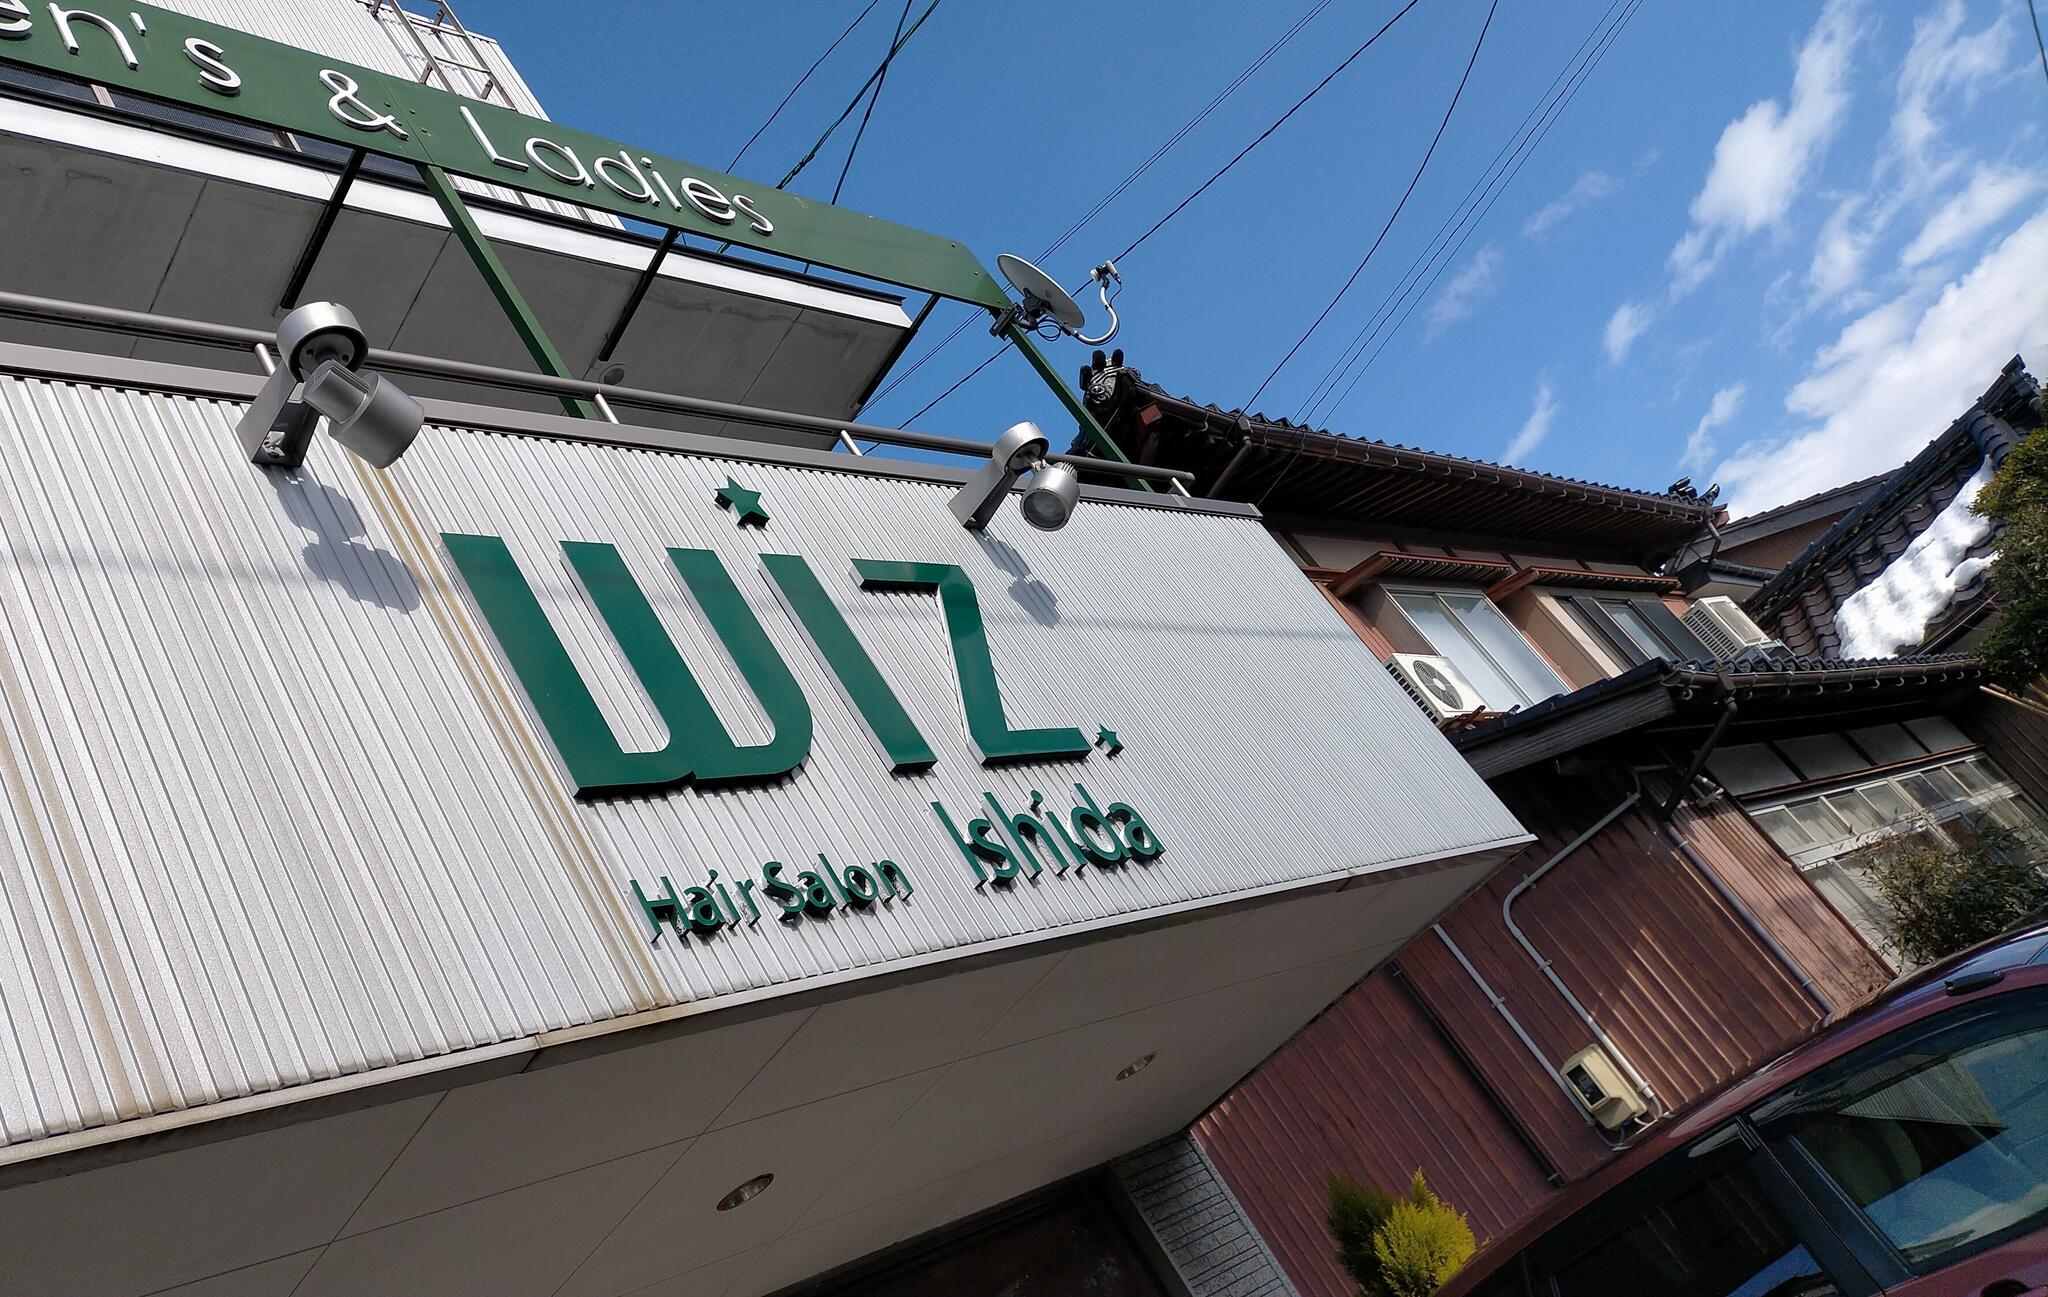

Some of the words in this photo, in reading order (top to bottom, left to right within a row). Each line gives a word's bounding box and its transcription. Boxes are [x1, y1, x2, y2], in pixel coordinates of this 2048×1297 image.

[319, 70, 409, 140] &
[459, 105, 774, 236] Ladies
[931, 783, 1165, 890] Ishida
